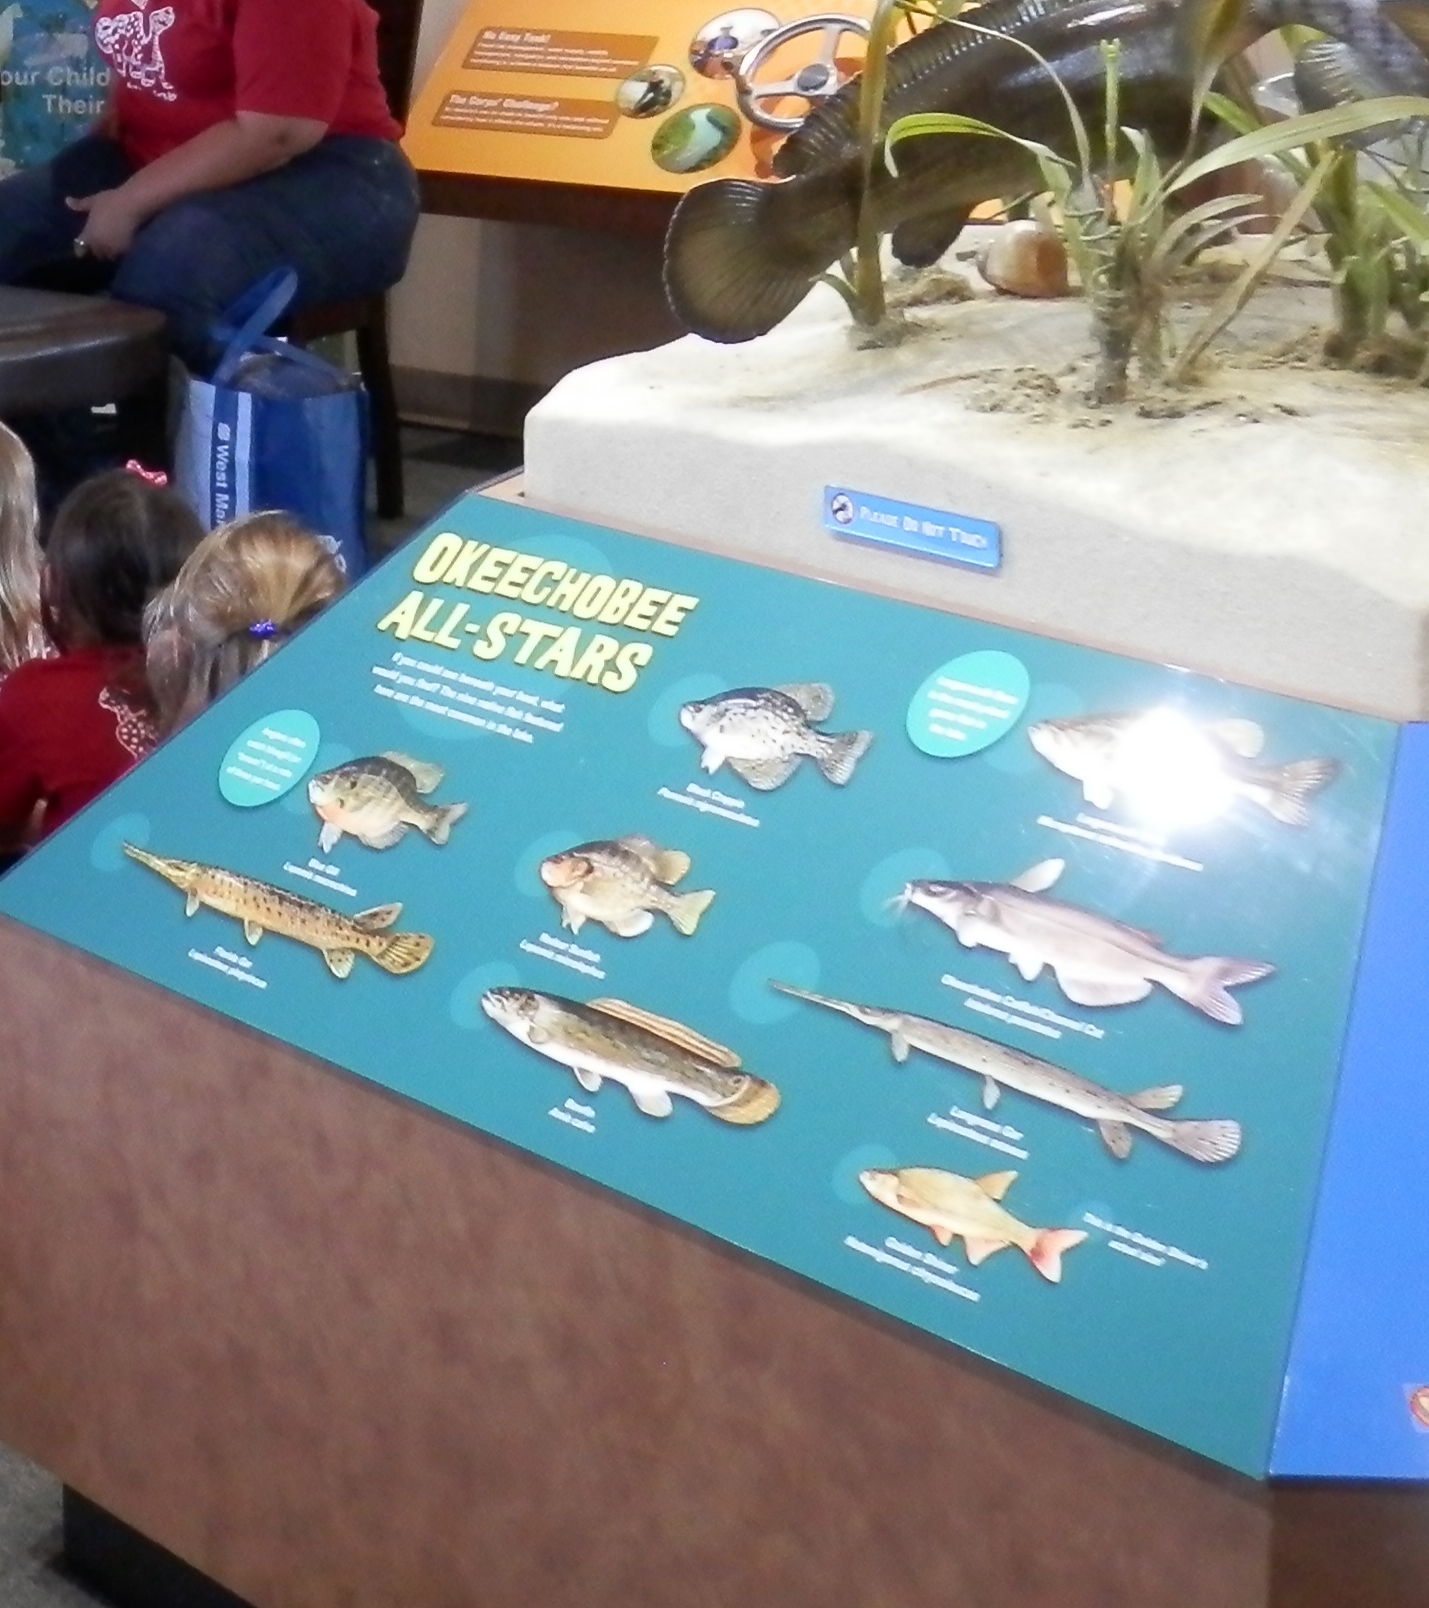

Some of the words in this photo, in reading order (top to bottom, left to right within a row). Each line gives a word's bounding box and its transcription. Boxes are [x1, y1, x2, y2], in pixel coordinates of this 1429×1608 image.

[0, 70, 40, 86] our
[46, 66, 111, 87] Child
[42, 95, 105, 114] Their
[215, 445, 231, 490] West
[215, 493, 231, 527] Mar
[412, 531, 701, 638] OKEECHOBEE
[376, 589, 654, 694] ALL-STARS
